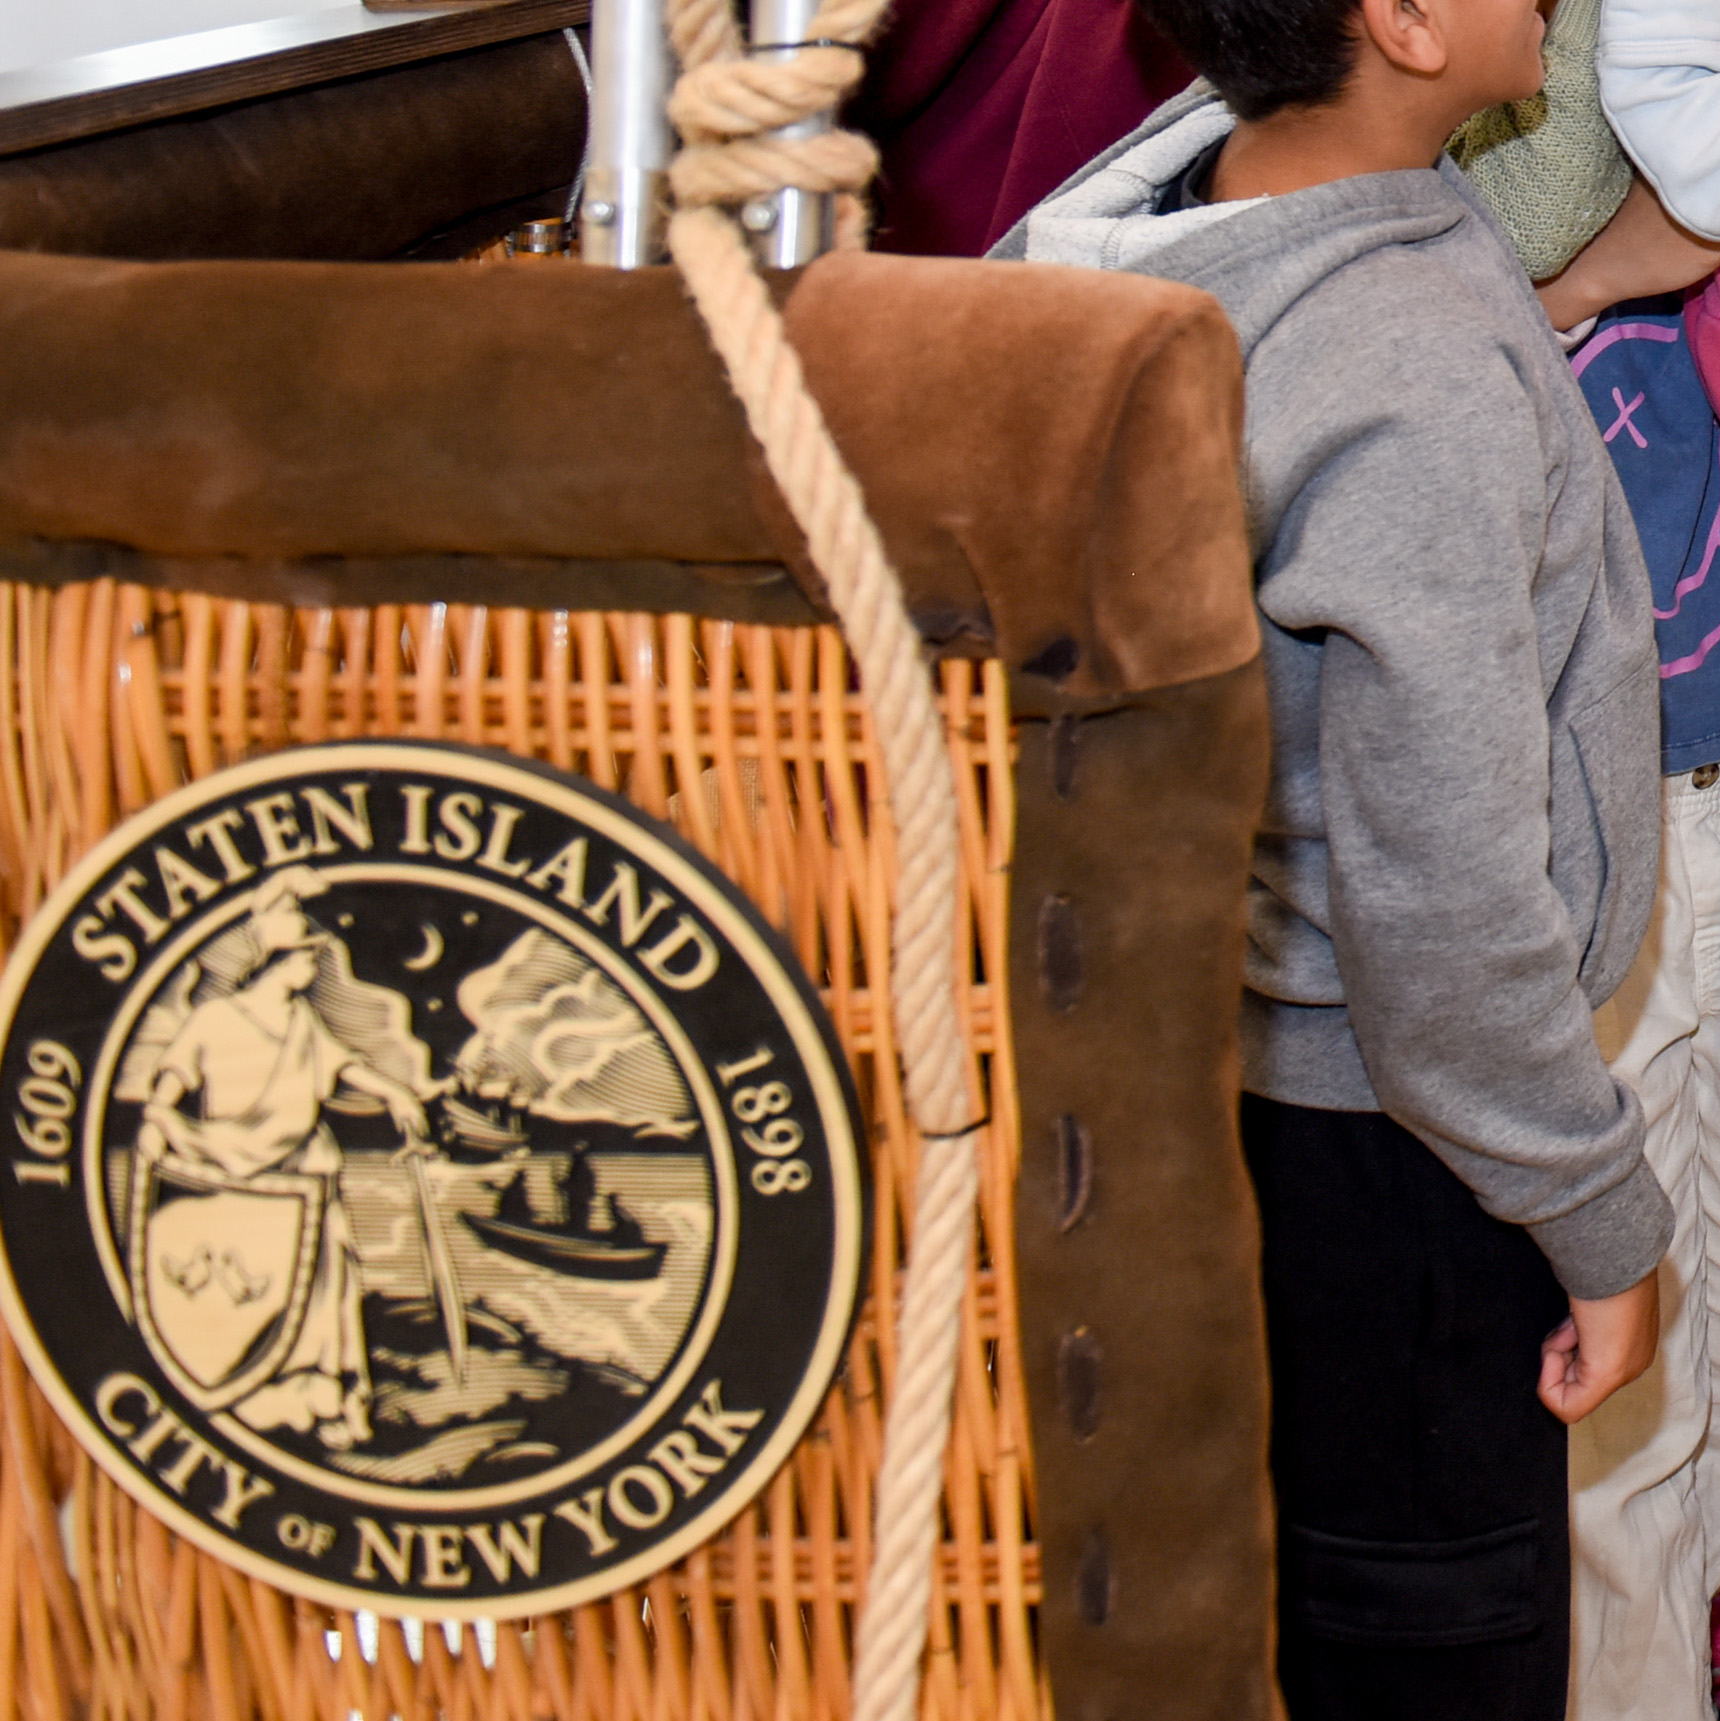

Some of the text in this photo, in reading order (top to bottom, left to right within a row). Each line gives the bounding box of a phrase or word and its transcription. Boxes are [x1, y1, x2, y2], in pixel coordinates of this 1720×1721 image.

[71, 783, 721, 994] STATEN ISLAND
[14, 1040, 83, 1189] 1609
[717, 1046, 812, 1197] 1898
[93, 1370, 766, 1589] CITY OF NEW YORK
